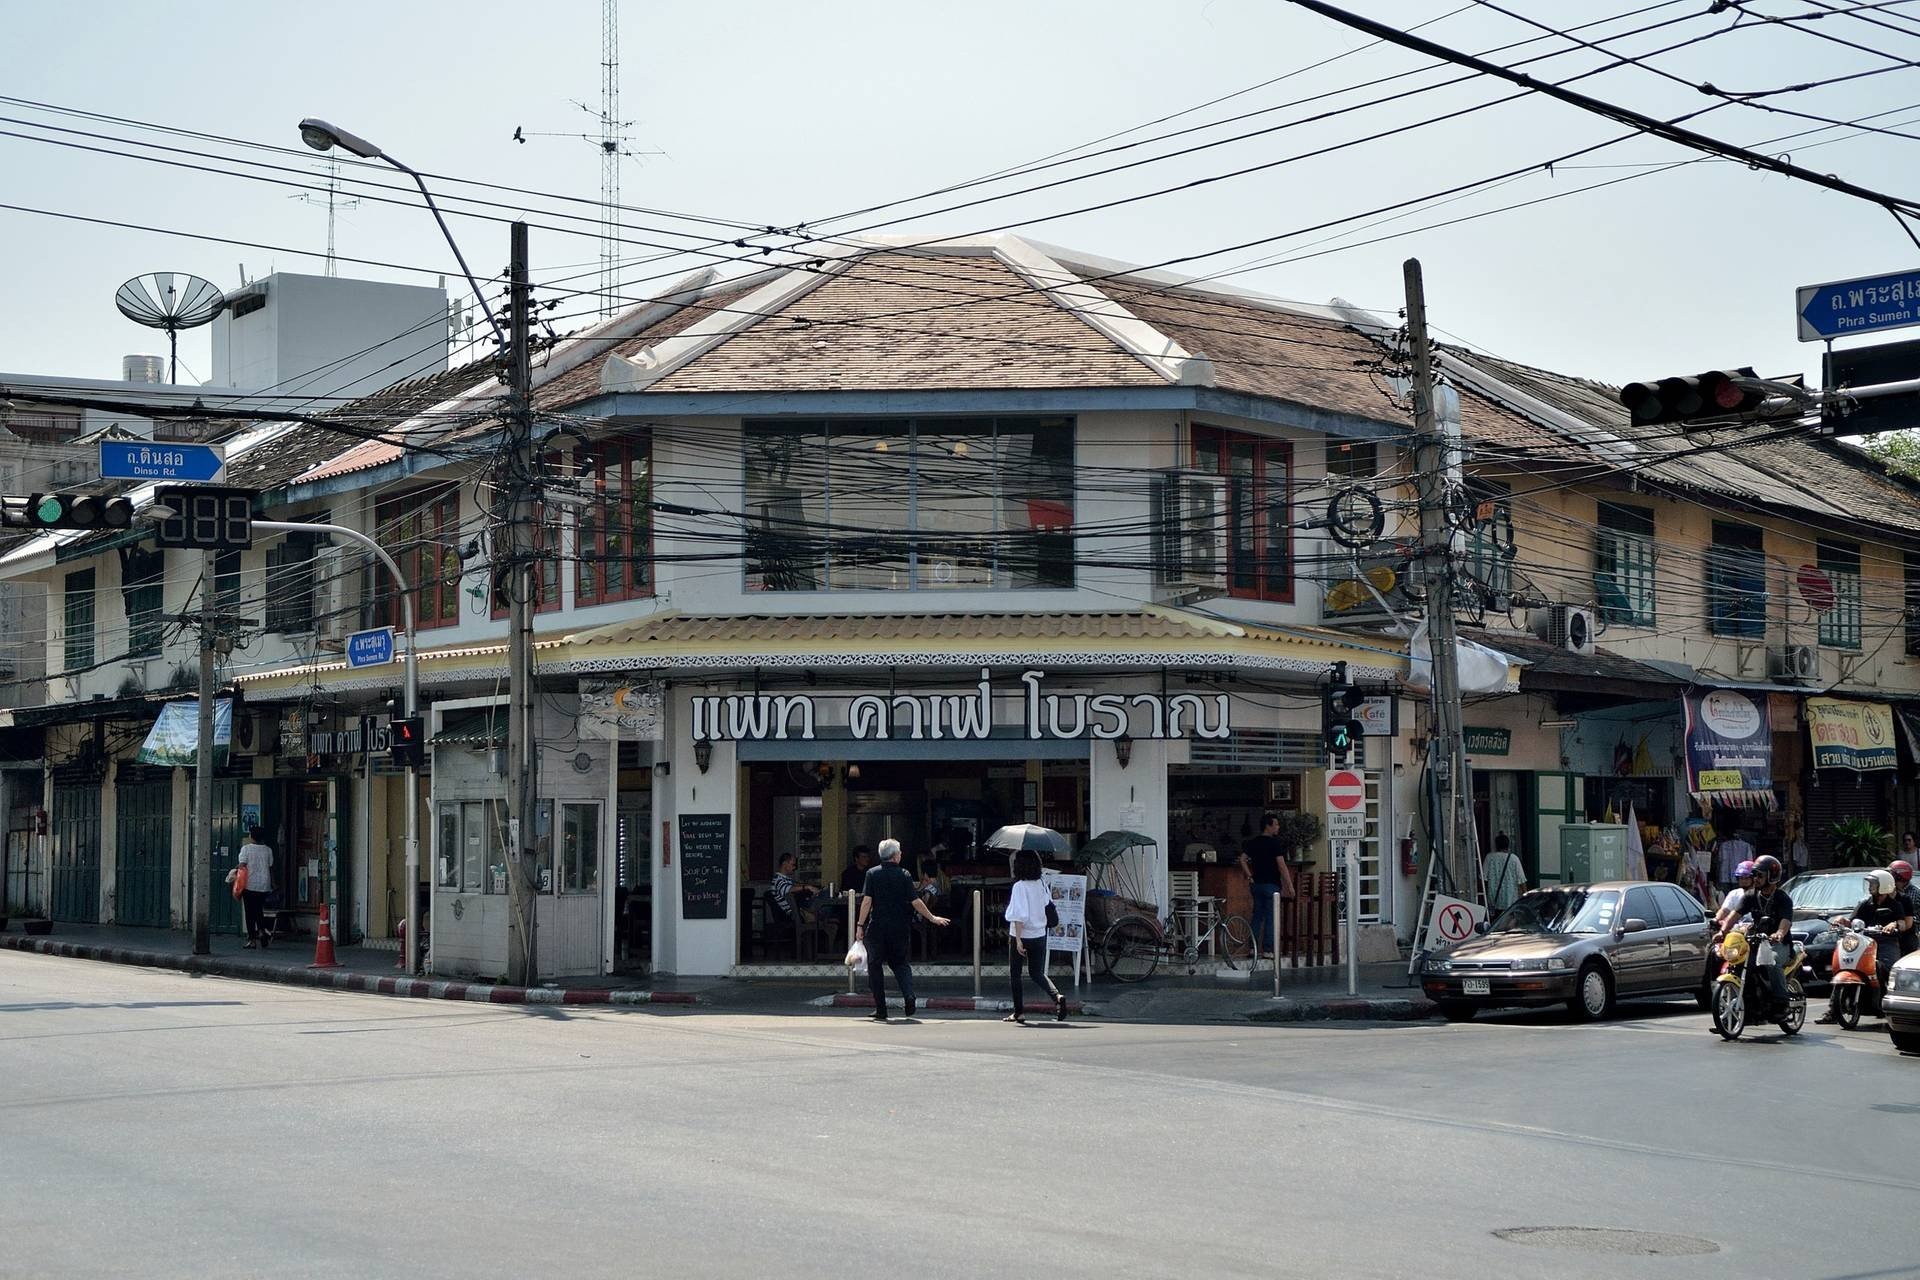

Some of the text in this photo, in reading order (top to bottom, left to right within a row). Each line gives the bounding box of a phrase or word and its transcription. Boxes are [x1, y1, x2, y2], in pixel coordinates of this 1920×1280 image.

[1838, 316, 1865, 329] Phra
[1869, 310, 1911, 323] Sumen
[127, 447, 184, 466] ถ.ดินสอ
[134, 466, 177, 476] Dinso Rd.
[692, 667, 1231, 741] แพท คาเฟ่ โบราณ
[1333, 814, 1358, 825] เดินรถ
[1330, 825, 1363, 837] ทางเดียว
